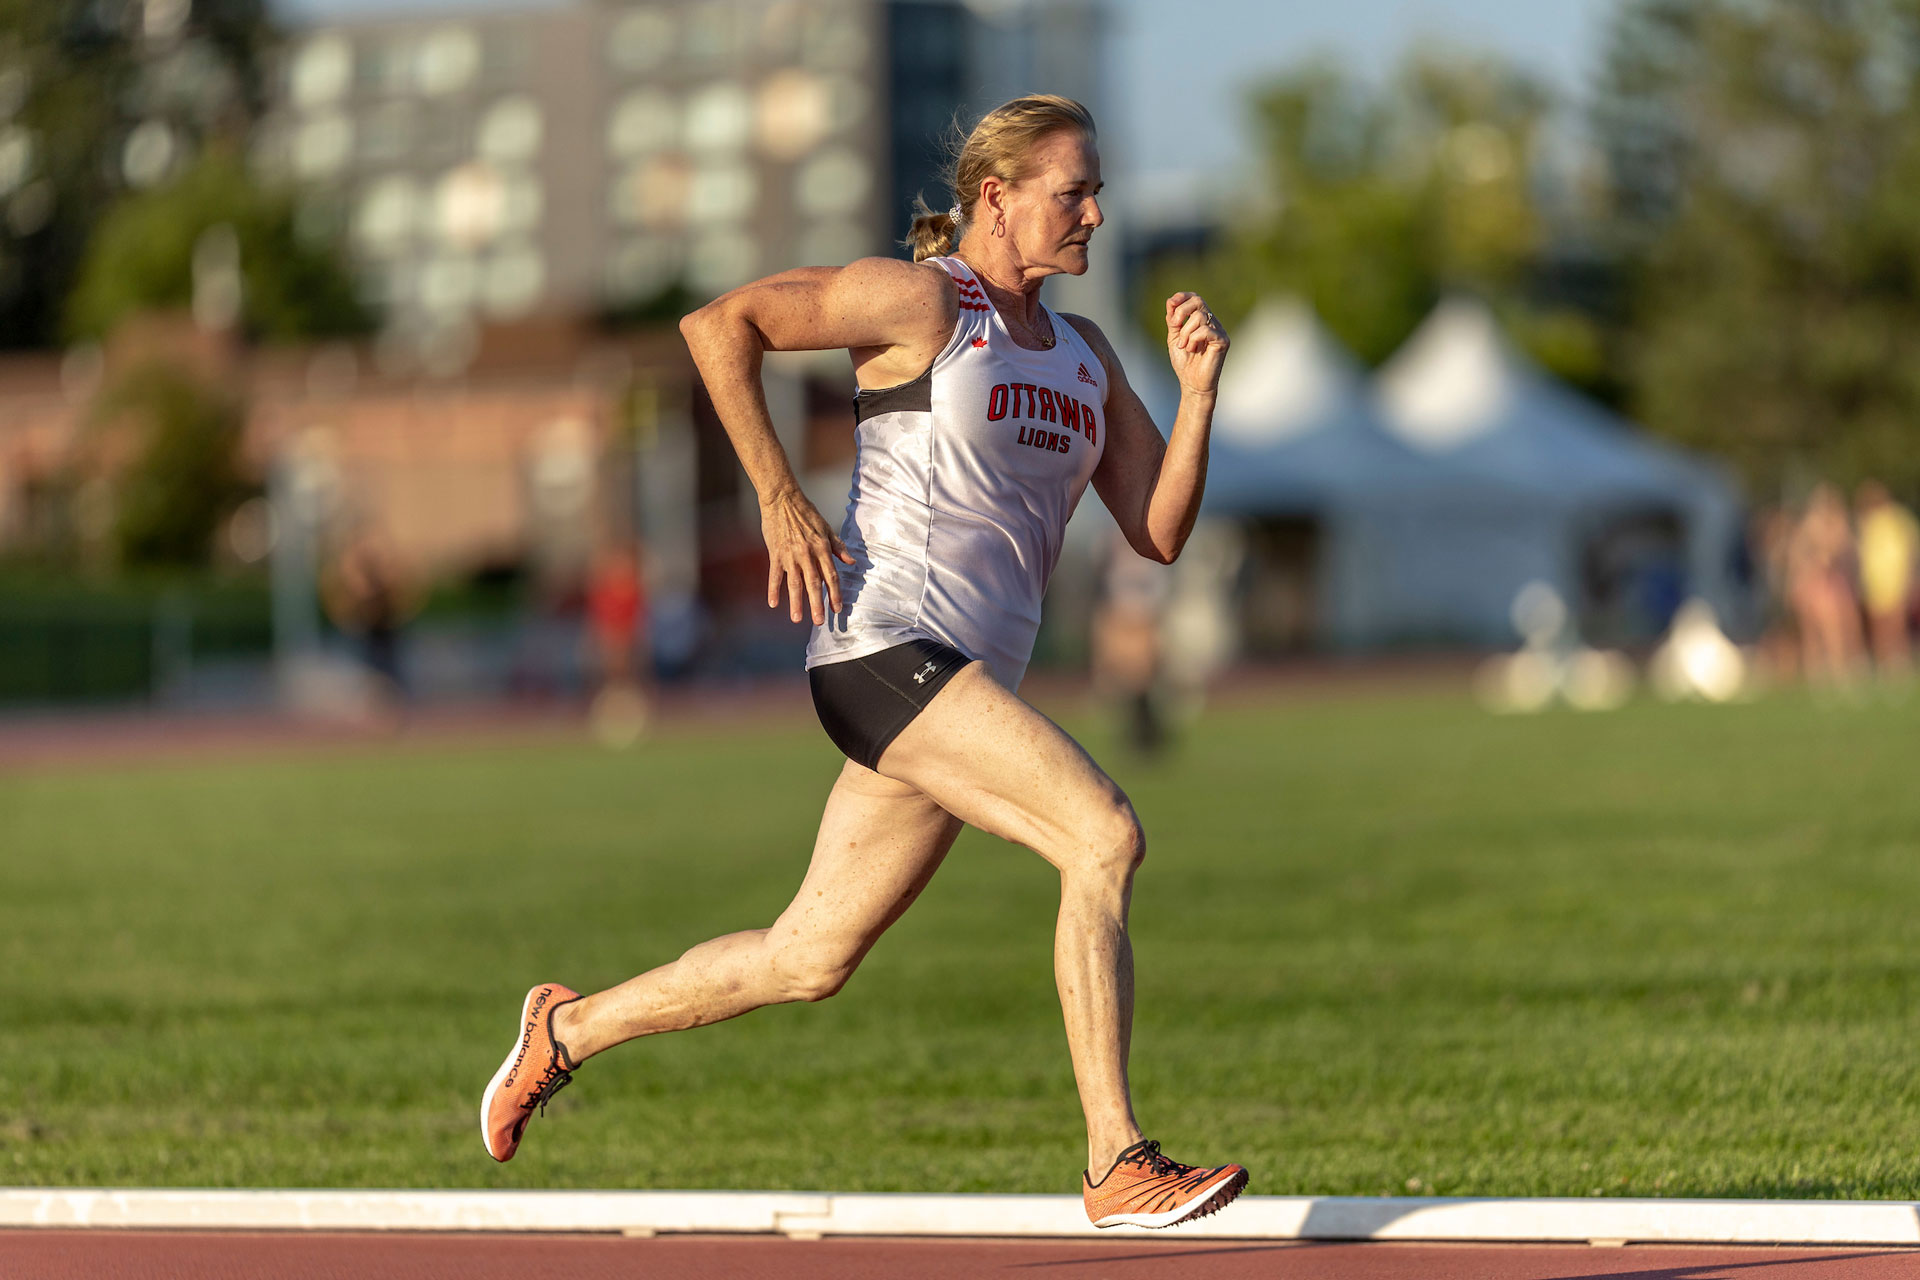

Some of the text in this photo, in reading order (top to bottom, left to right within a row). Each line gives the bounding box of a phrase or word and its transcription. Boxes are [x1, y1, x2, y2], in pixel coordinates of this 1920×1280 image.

[987, 383, 1097, 447] OTTAWA
[1017, 426, 1071, 454] LIONS
[505, 988, 552, 1087] new balance
